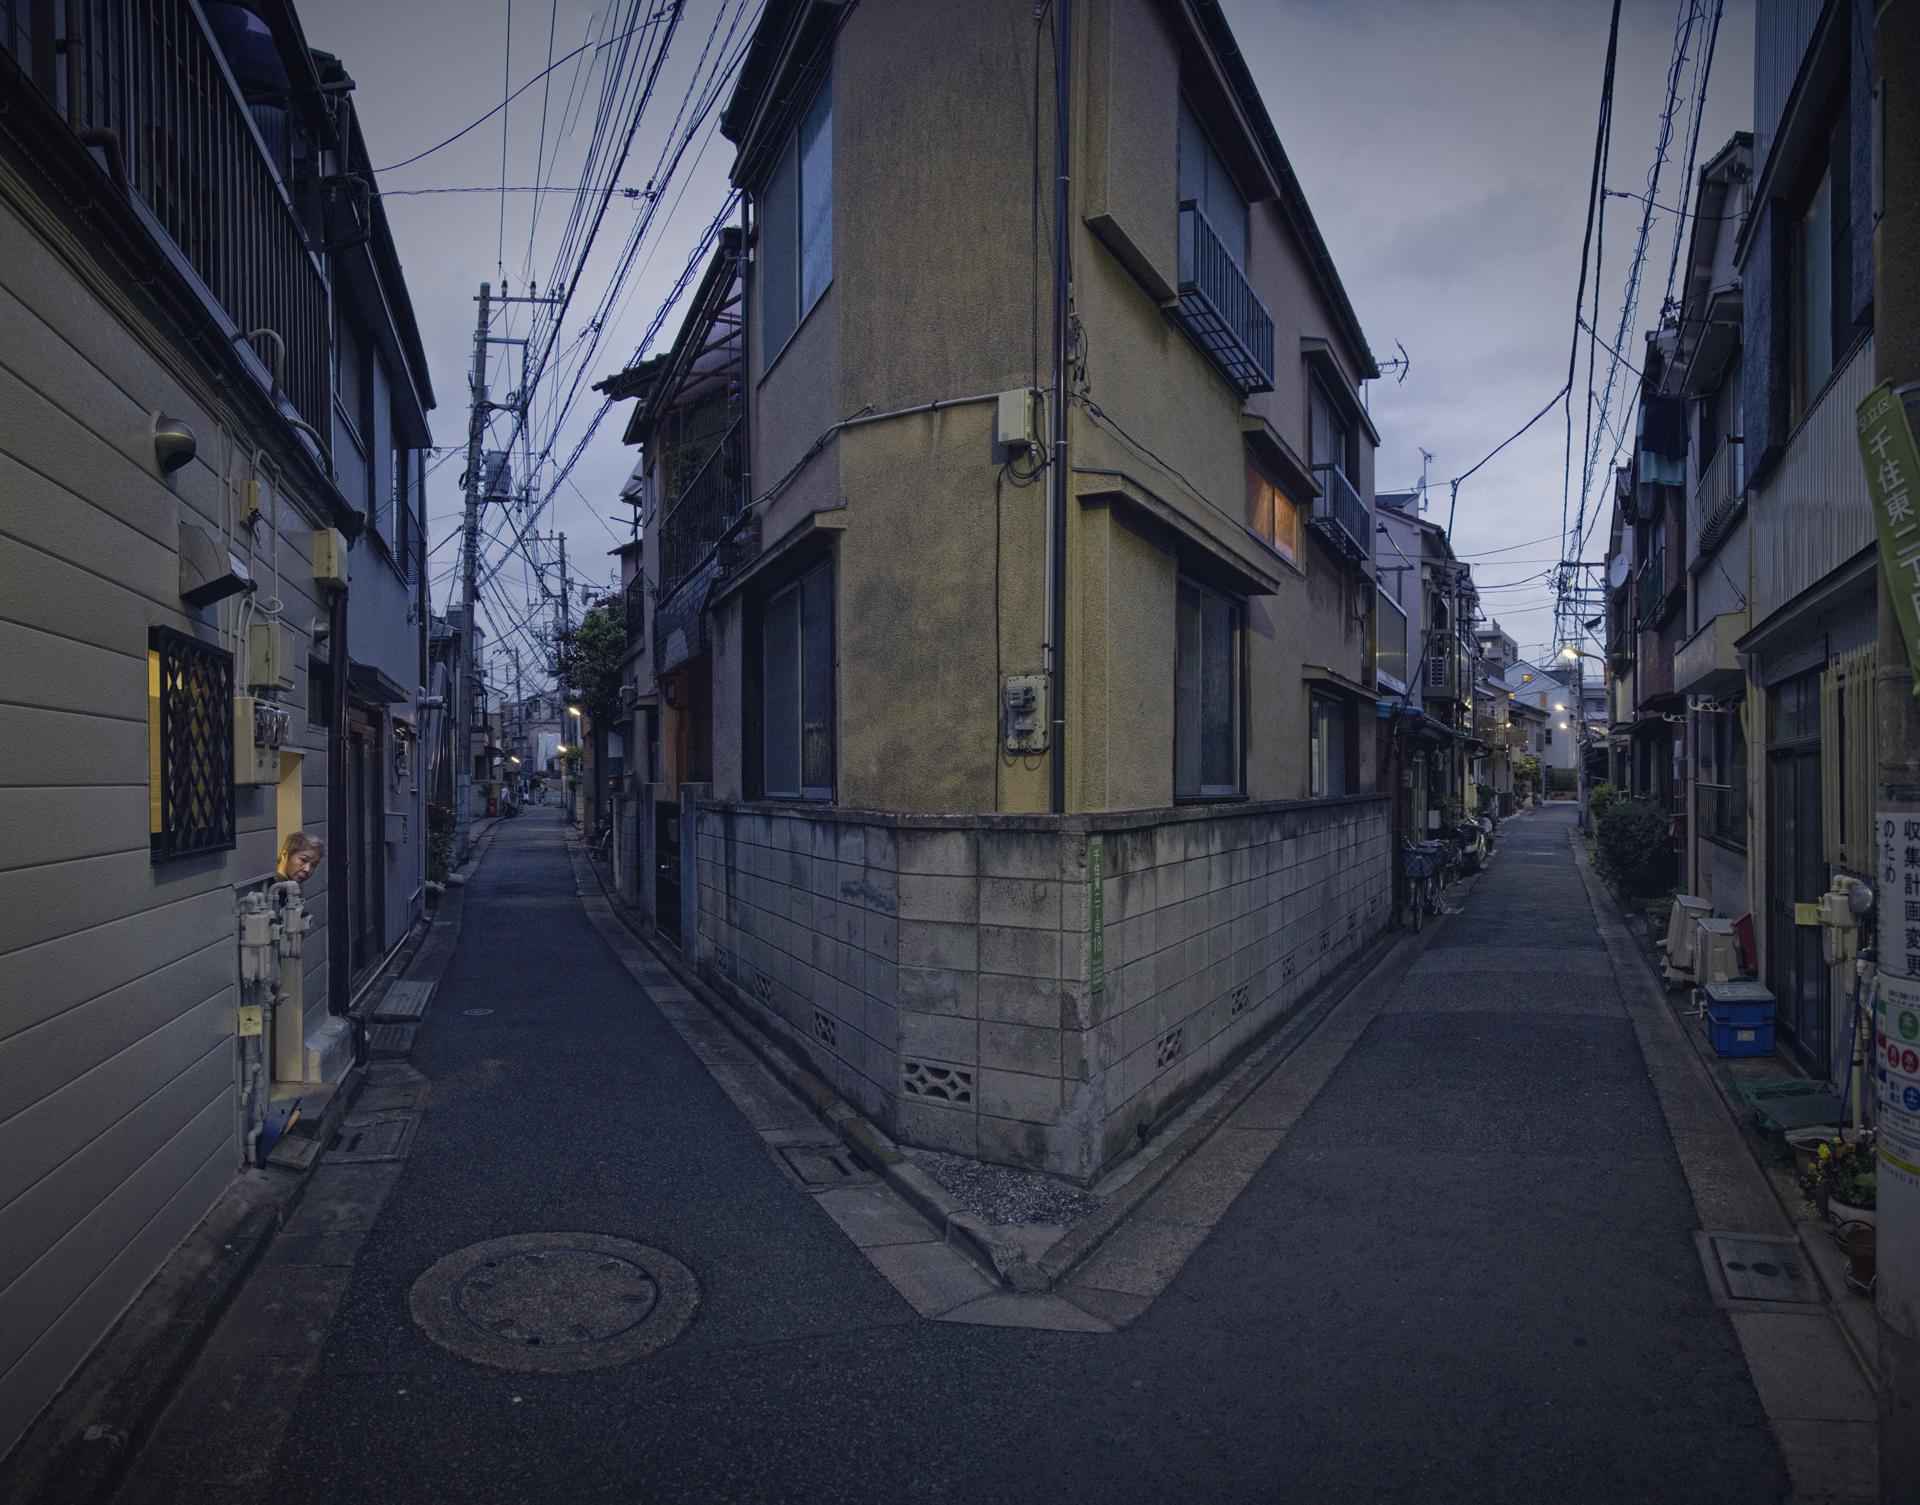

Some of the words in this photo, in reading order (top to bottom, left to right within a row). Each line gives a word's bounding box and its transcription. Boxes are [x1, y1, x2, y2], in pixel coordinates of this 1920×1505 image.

[1884, 820, 1896, 884] のため
[1094, 935, 1102, 953] 18
